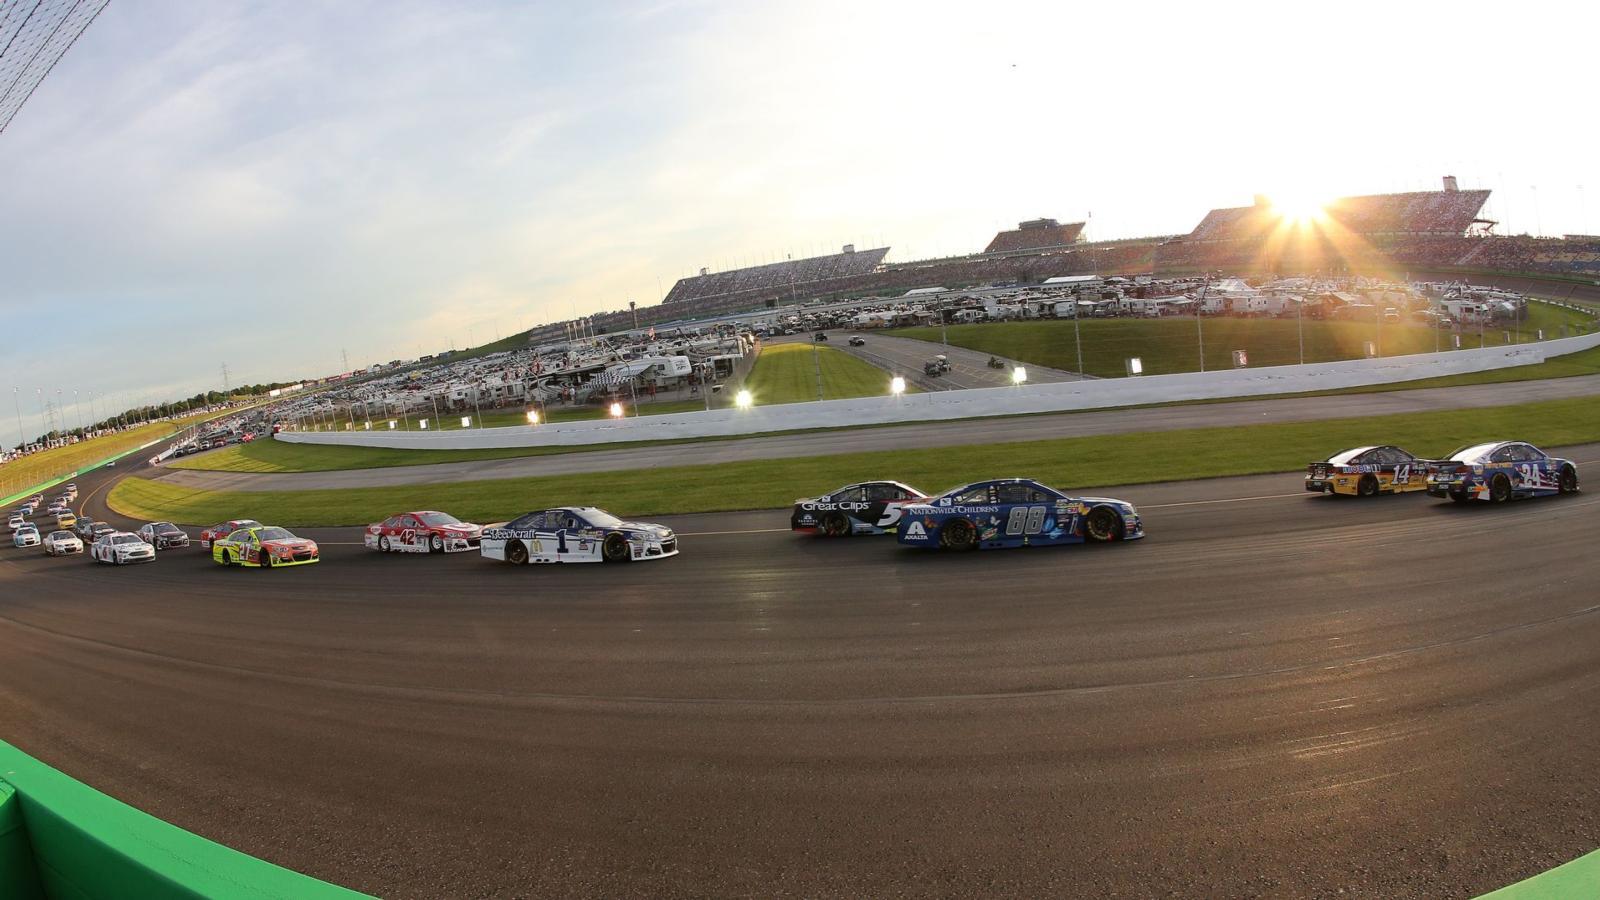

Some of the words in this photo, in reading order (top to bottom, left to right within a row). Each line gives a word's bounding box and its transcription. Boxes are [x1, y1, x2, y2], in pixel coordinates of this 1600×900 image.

[1391, 464, 1410, 485] 14
[1521, 463, 1540, 487] 24
[801, 502, 837, 511] Great
[839, 501, 869, 513] Clips
[877, 503, 903, 526] 5
[910, 506, 956, 517] NATIONWIDE
[957, 506, 1000, 516] CHILDREN'S
[1005, 506, 1047, 536] 88
[399, 528, 417, 546] 42
[490, 529, 536, 540] Beechcraft
[555, 528, 569, 553] 1
[239, 541, 251, 561] 27
